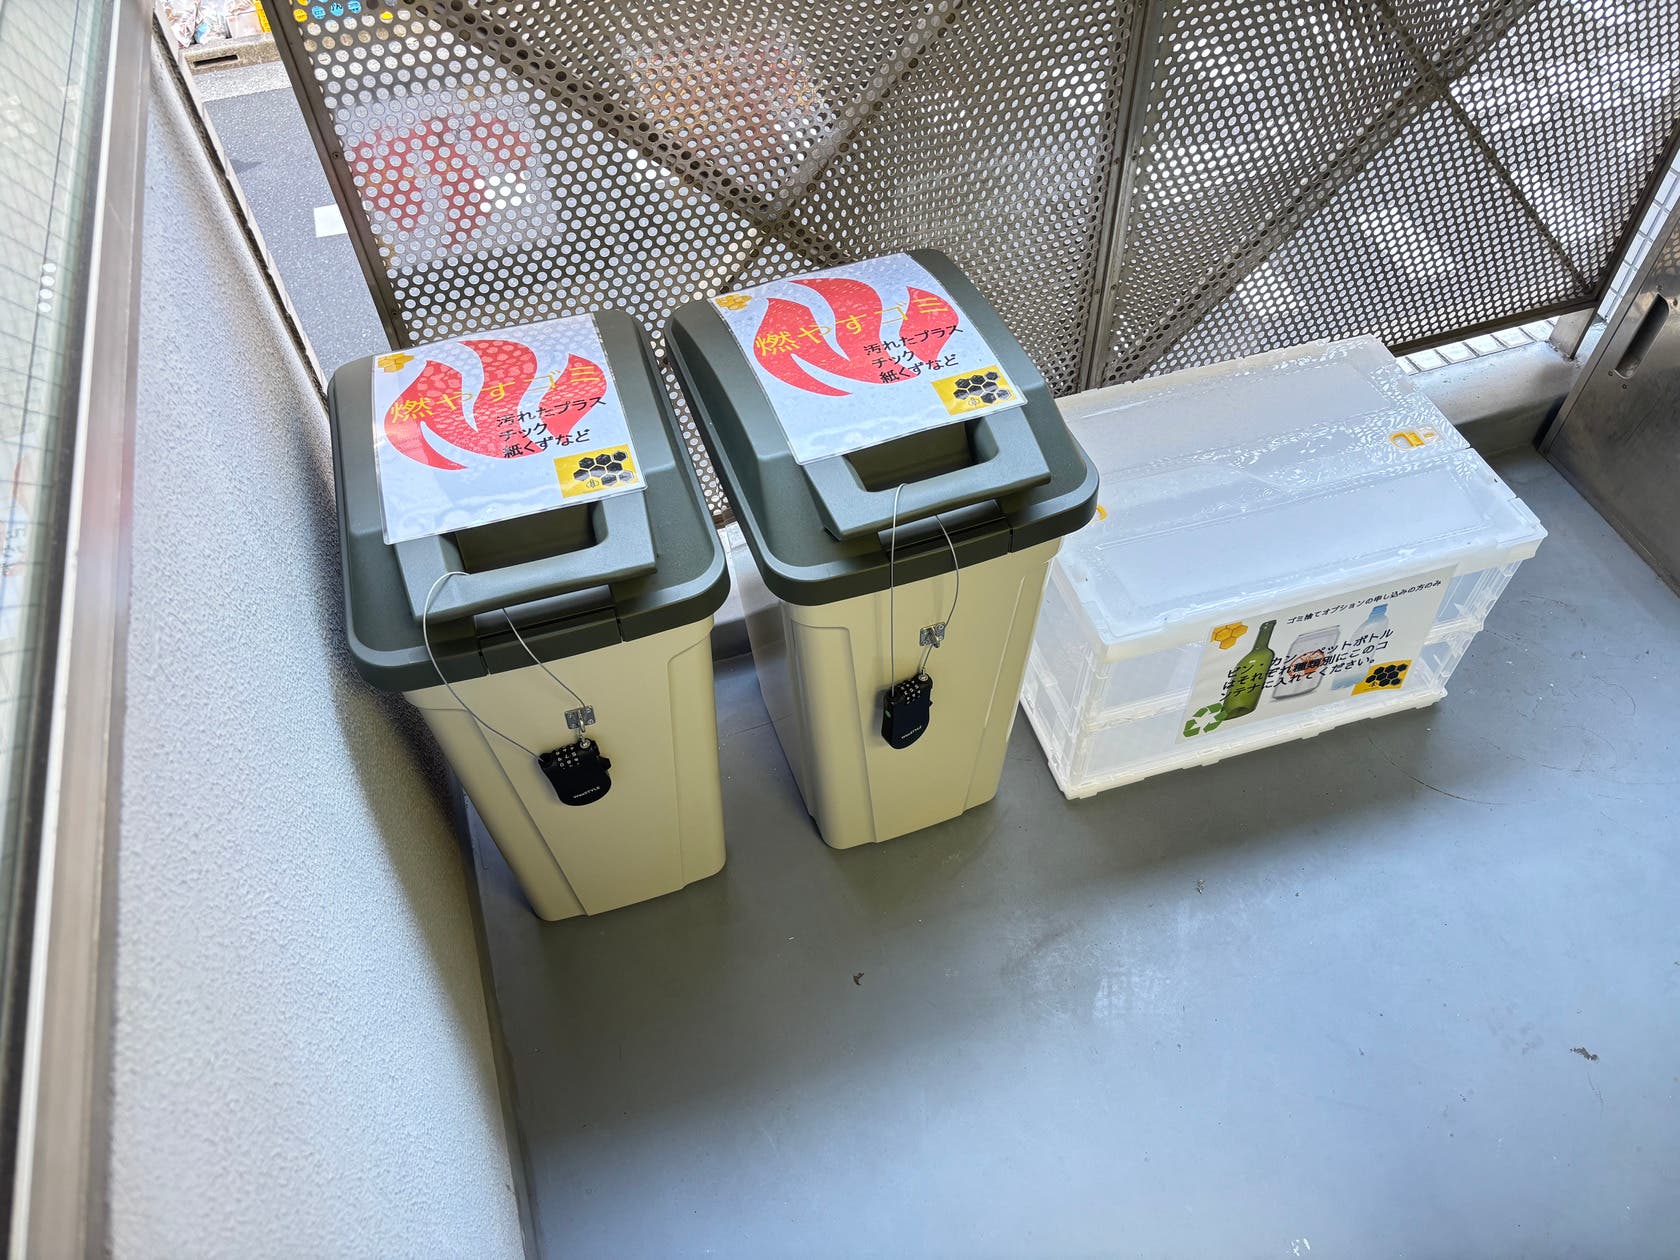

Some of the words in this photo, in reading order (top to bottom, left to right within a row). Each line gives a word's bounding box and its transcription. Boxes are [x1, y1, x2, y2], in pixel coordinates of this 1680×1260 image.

[755, 297, 948, 357] 燃やすゴミ
[864, 324, 963, 356] 汚れたプラス
[872, 350, 914, 367] チック
[880, 353, 959, 384] 紙くずなど
[390, 365, 600, 424] 燃やすゴミ
[496, 396, 607, 428] 汚れたプラス
[499, 422, 548, 442] チック
[503, 428, 591, 459] 紙くずなど
[1286, 580, 1442, 625] ゴミ捨てオプションの申し込みの方のみ
